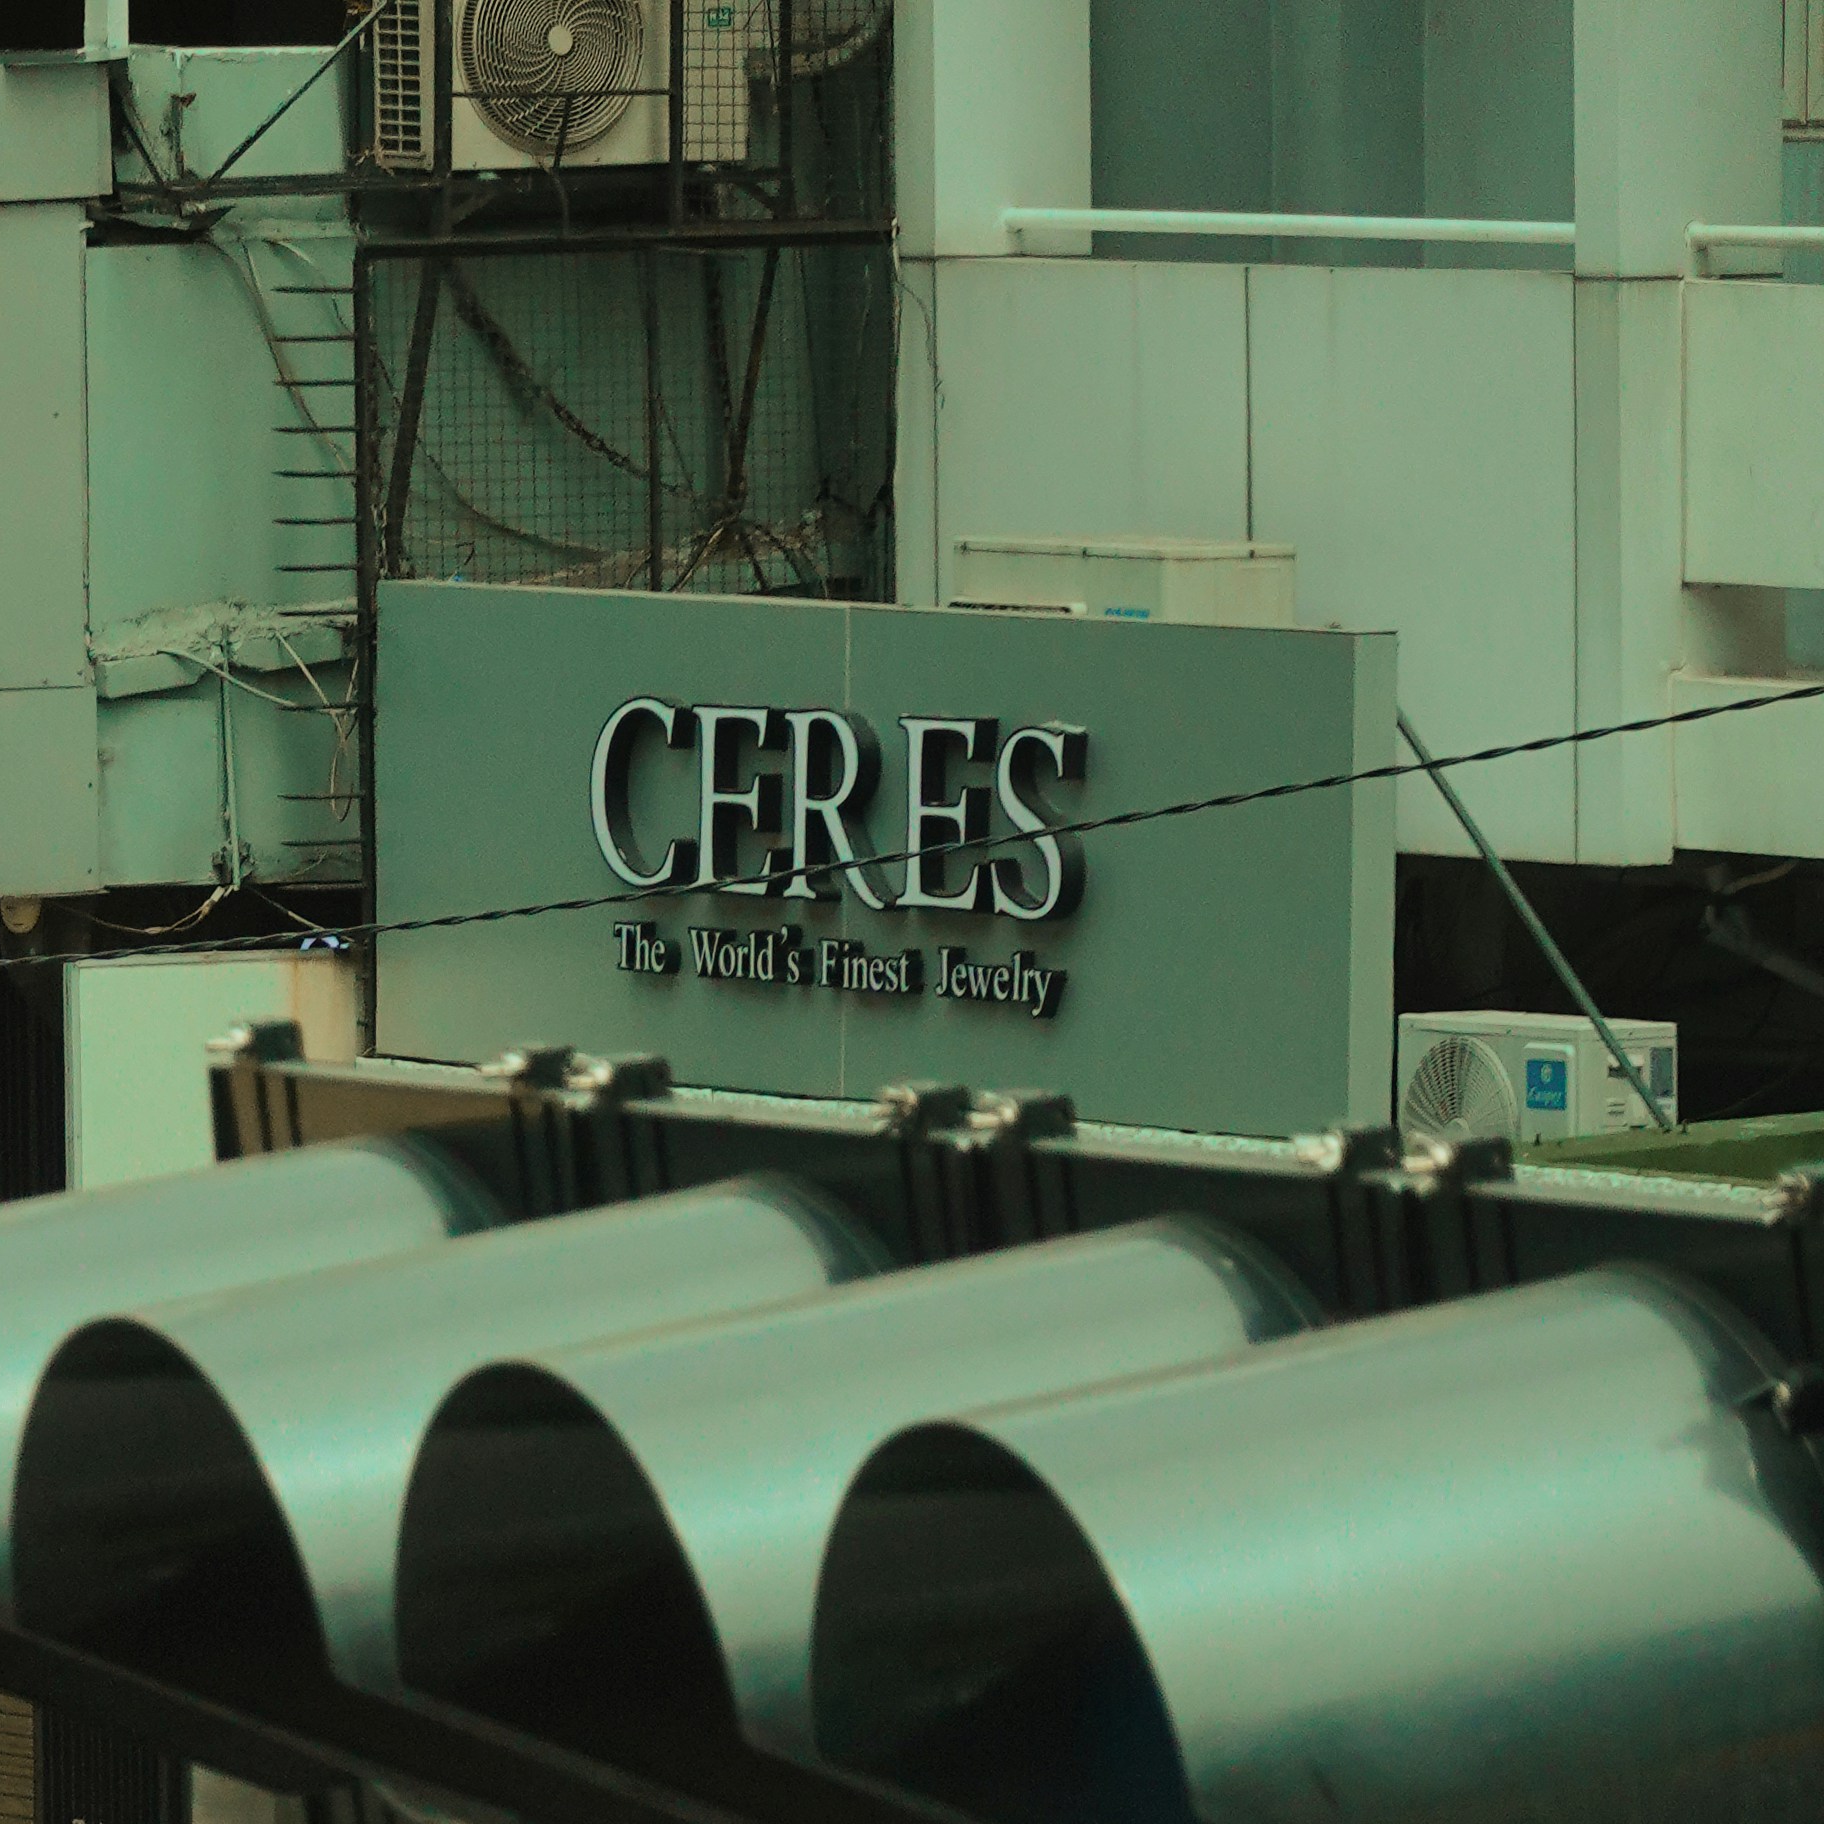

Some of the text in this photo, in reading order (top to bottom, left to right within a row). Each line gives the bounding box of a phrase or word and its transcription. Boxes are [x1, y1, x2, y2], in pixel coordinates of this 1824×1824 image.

[589, 696, 1068, 920] CERES
[613, 921, 1052, 1019] The World's Finest Jewelry
